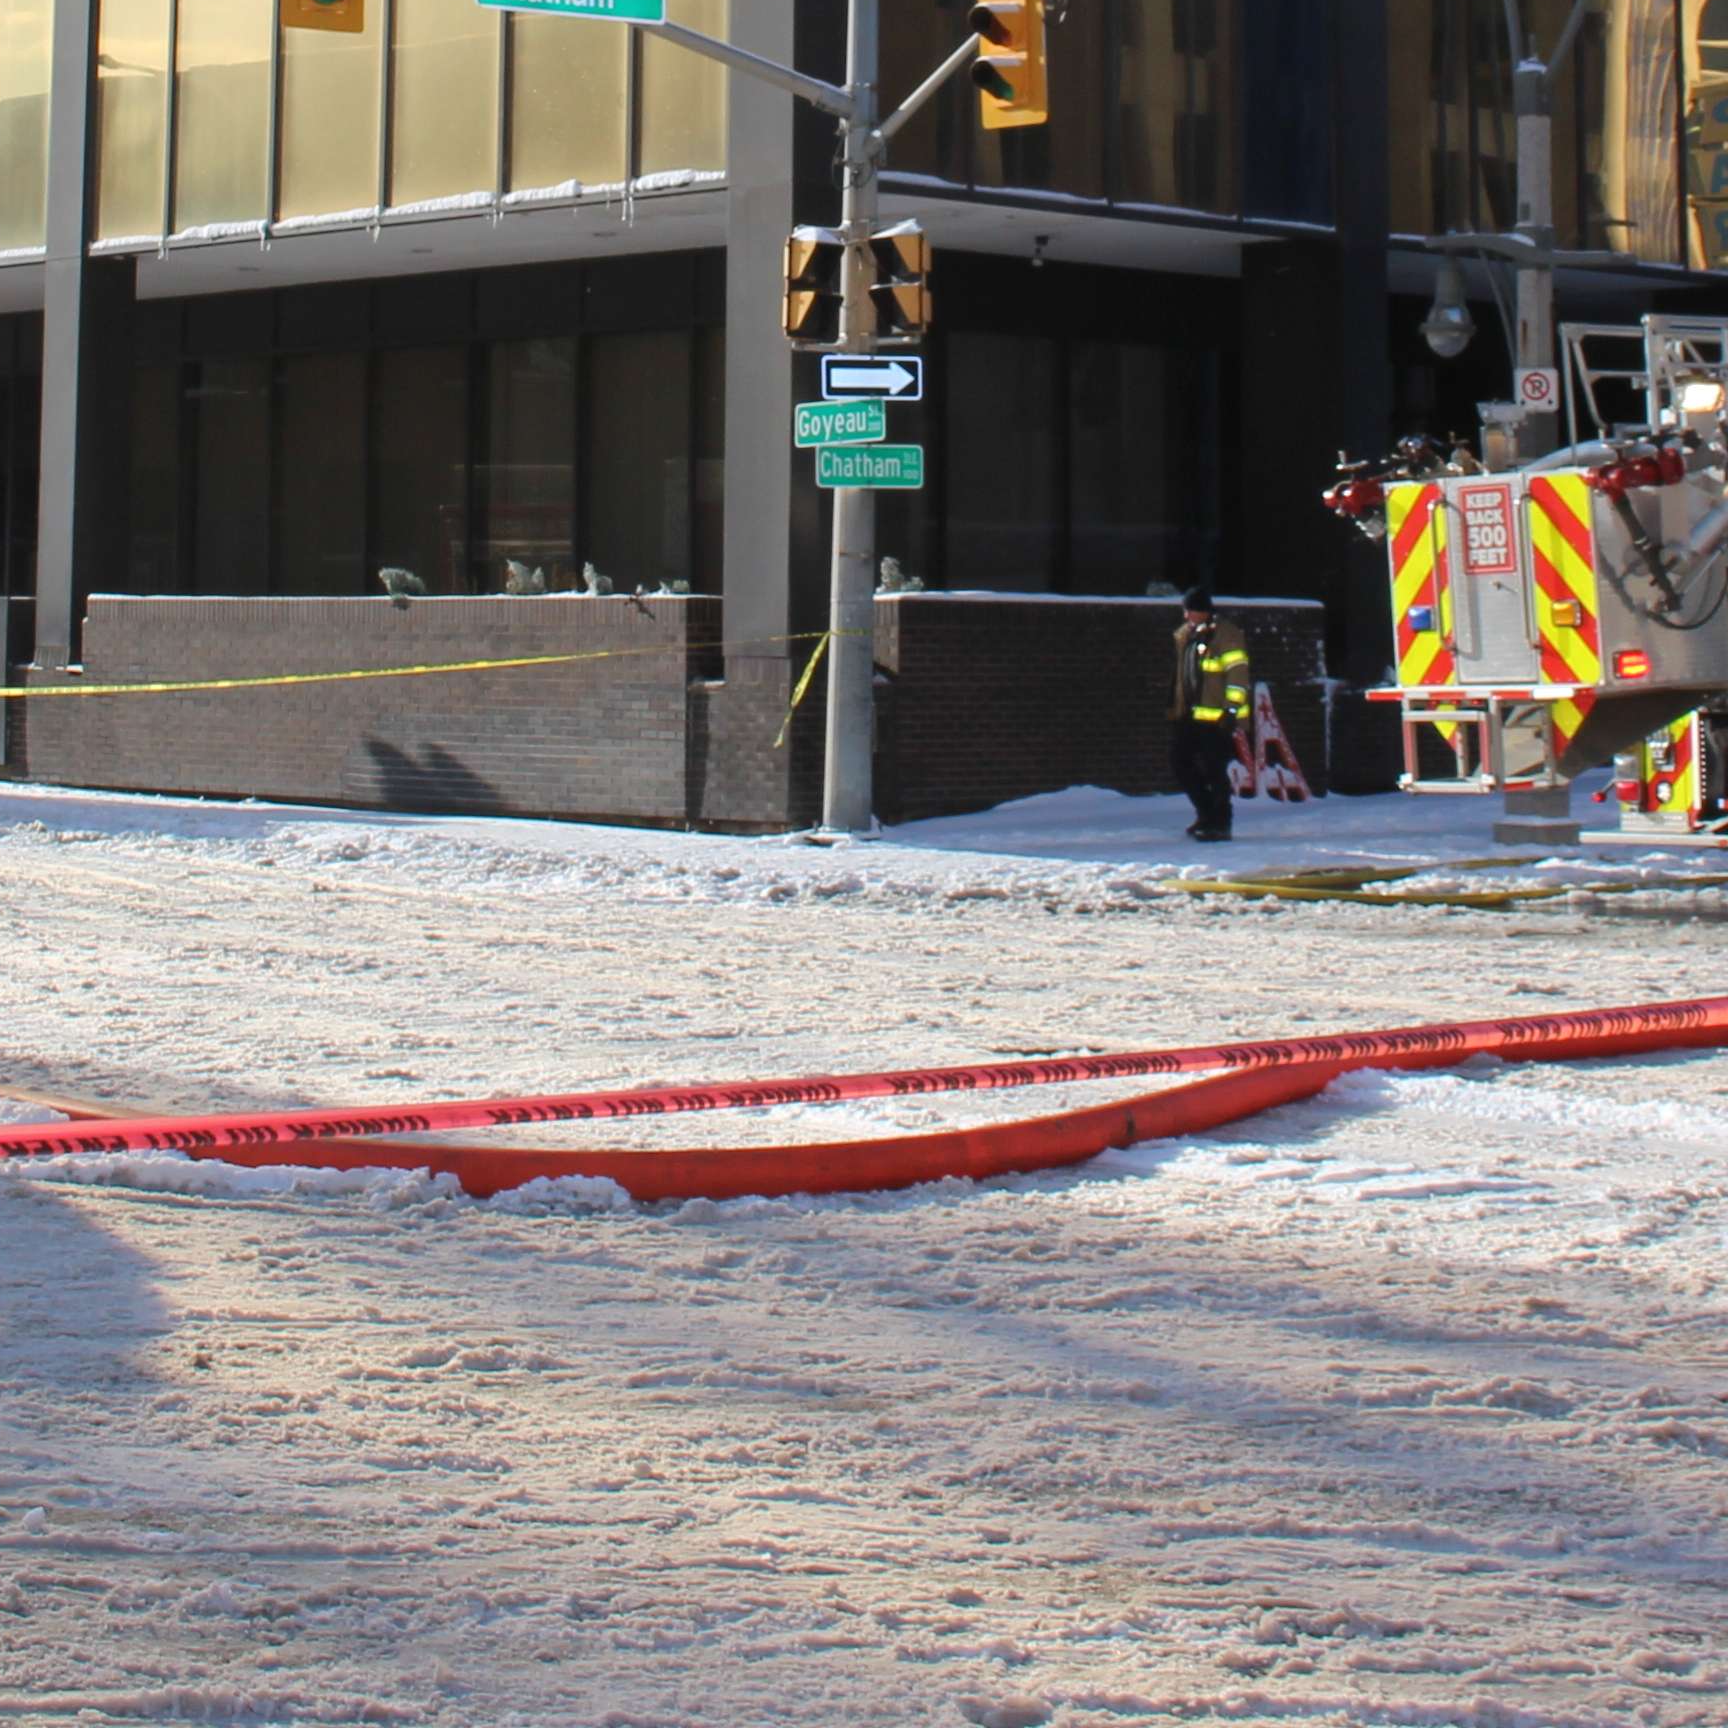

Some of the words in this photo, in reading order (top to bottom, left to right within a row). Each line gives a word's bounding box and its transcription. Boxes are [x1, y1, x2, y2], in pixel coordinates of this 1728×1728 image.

[799, 411, 867, 441] Goyeau
[822, 451, 901, 478] Chatham
[1466, 491, 1502, 508] KEEP
[1466, 509, 1504, 526] BACK
[1468, 525, 1507, 548] 500
[1469, 547, 1507, 566] FEET
